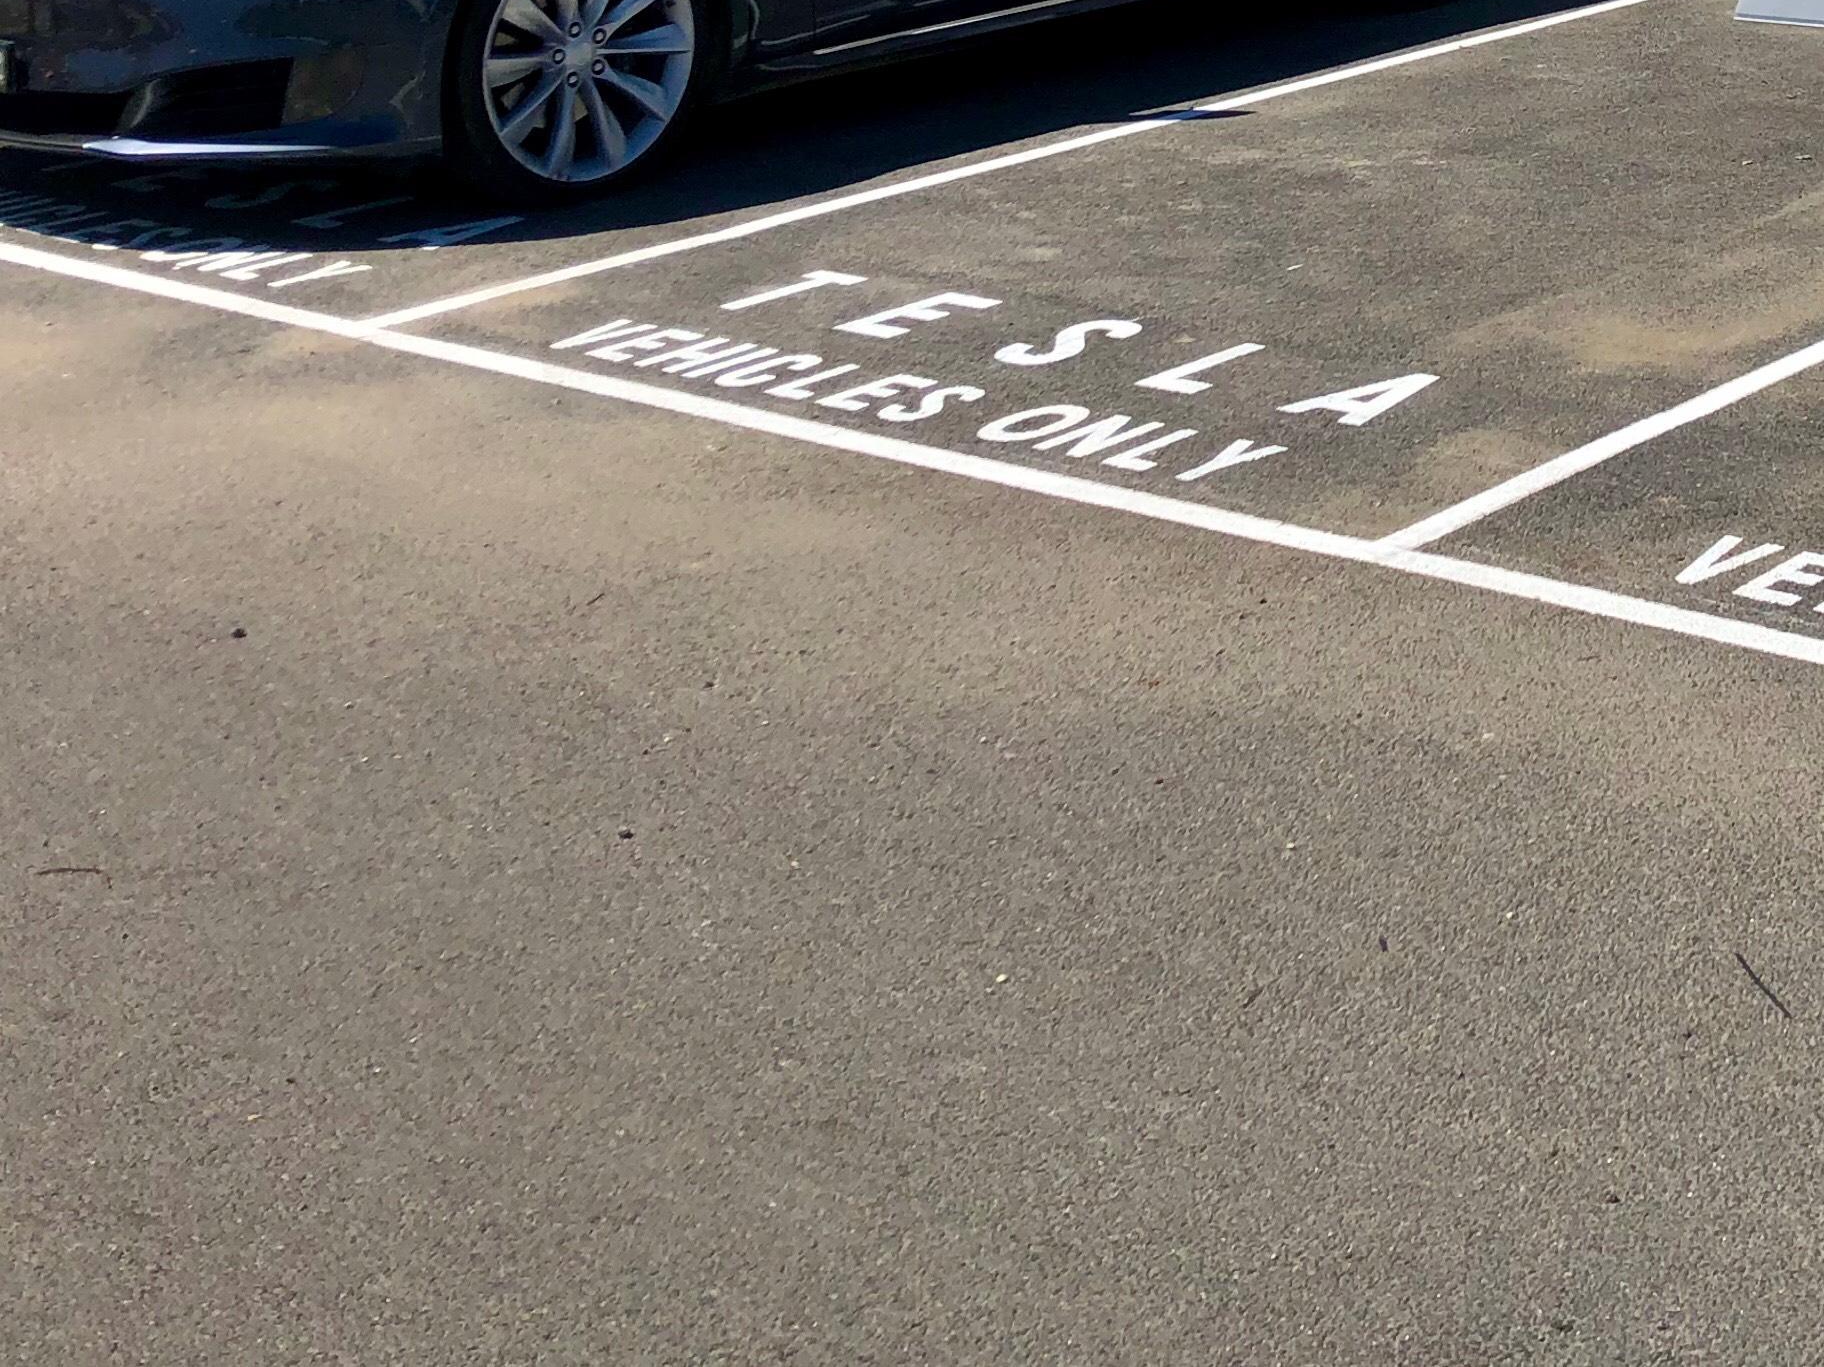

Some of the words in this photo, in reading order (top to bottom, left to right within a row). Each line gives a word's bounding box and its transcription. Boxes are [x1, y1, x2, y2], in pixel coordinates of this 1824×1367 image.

[550, 319, 985, 422] VEHICLES
[977, 405, 1288, 481] ONLY
[720, 270, 1440, 426] TESLA
